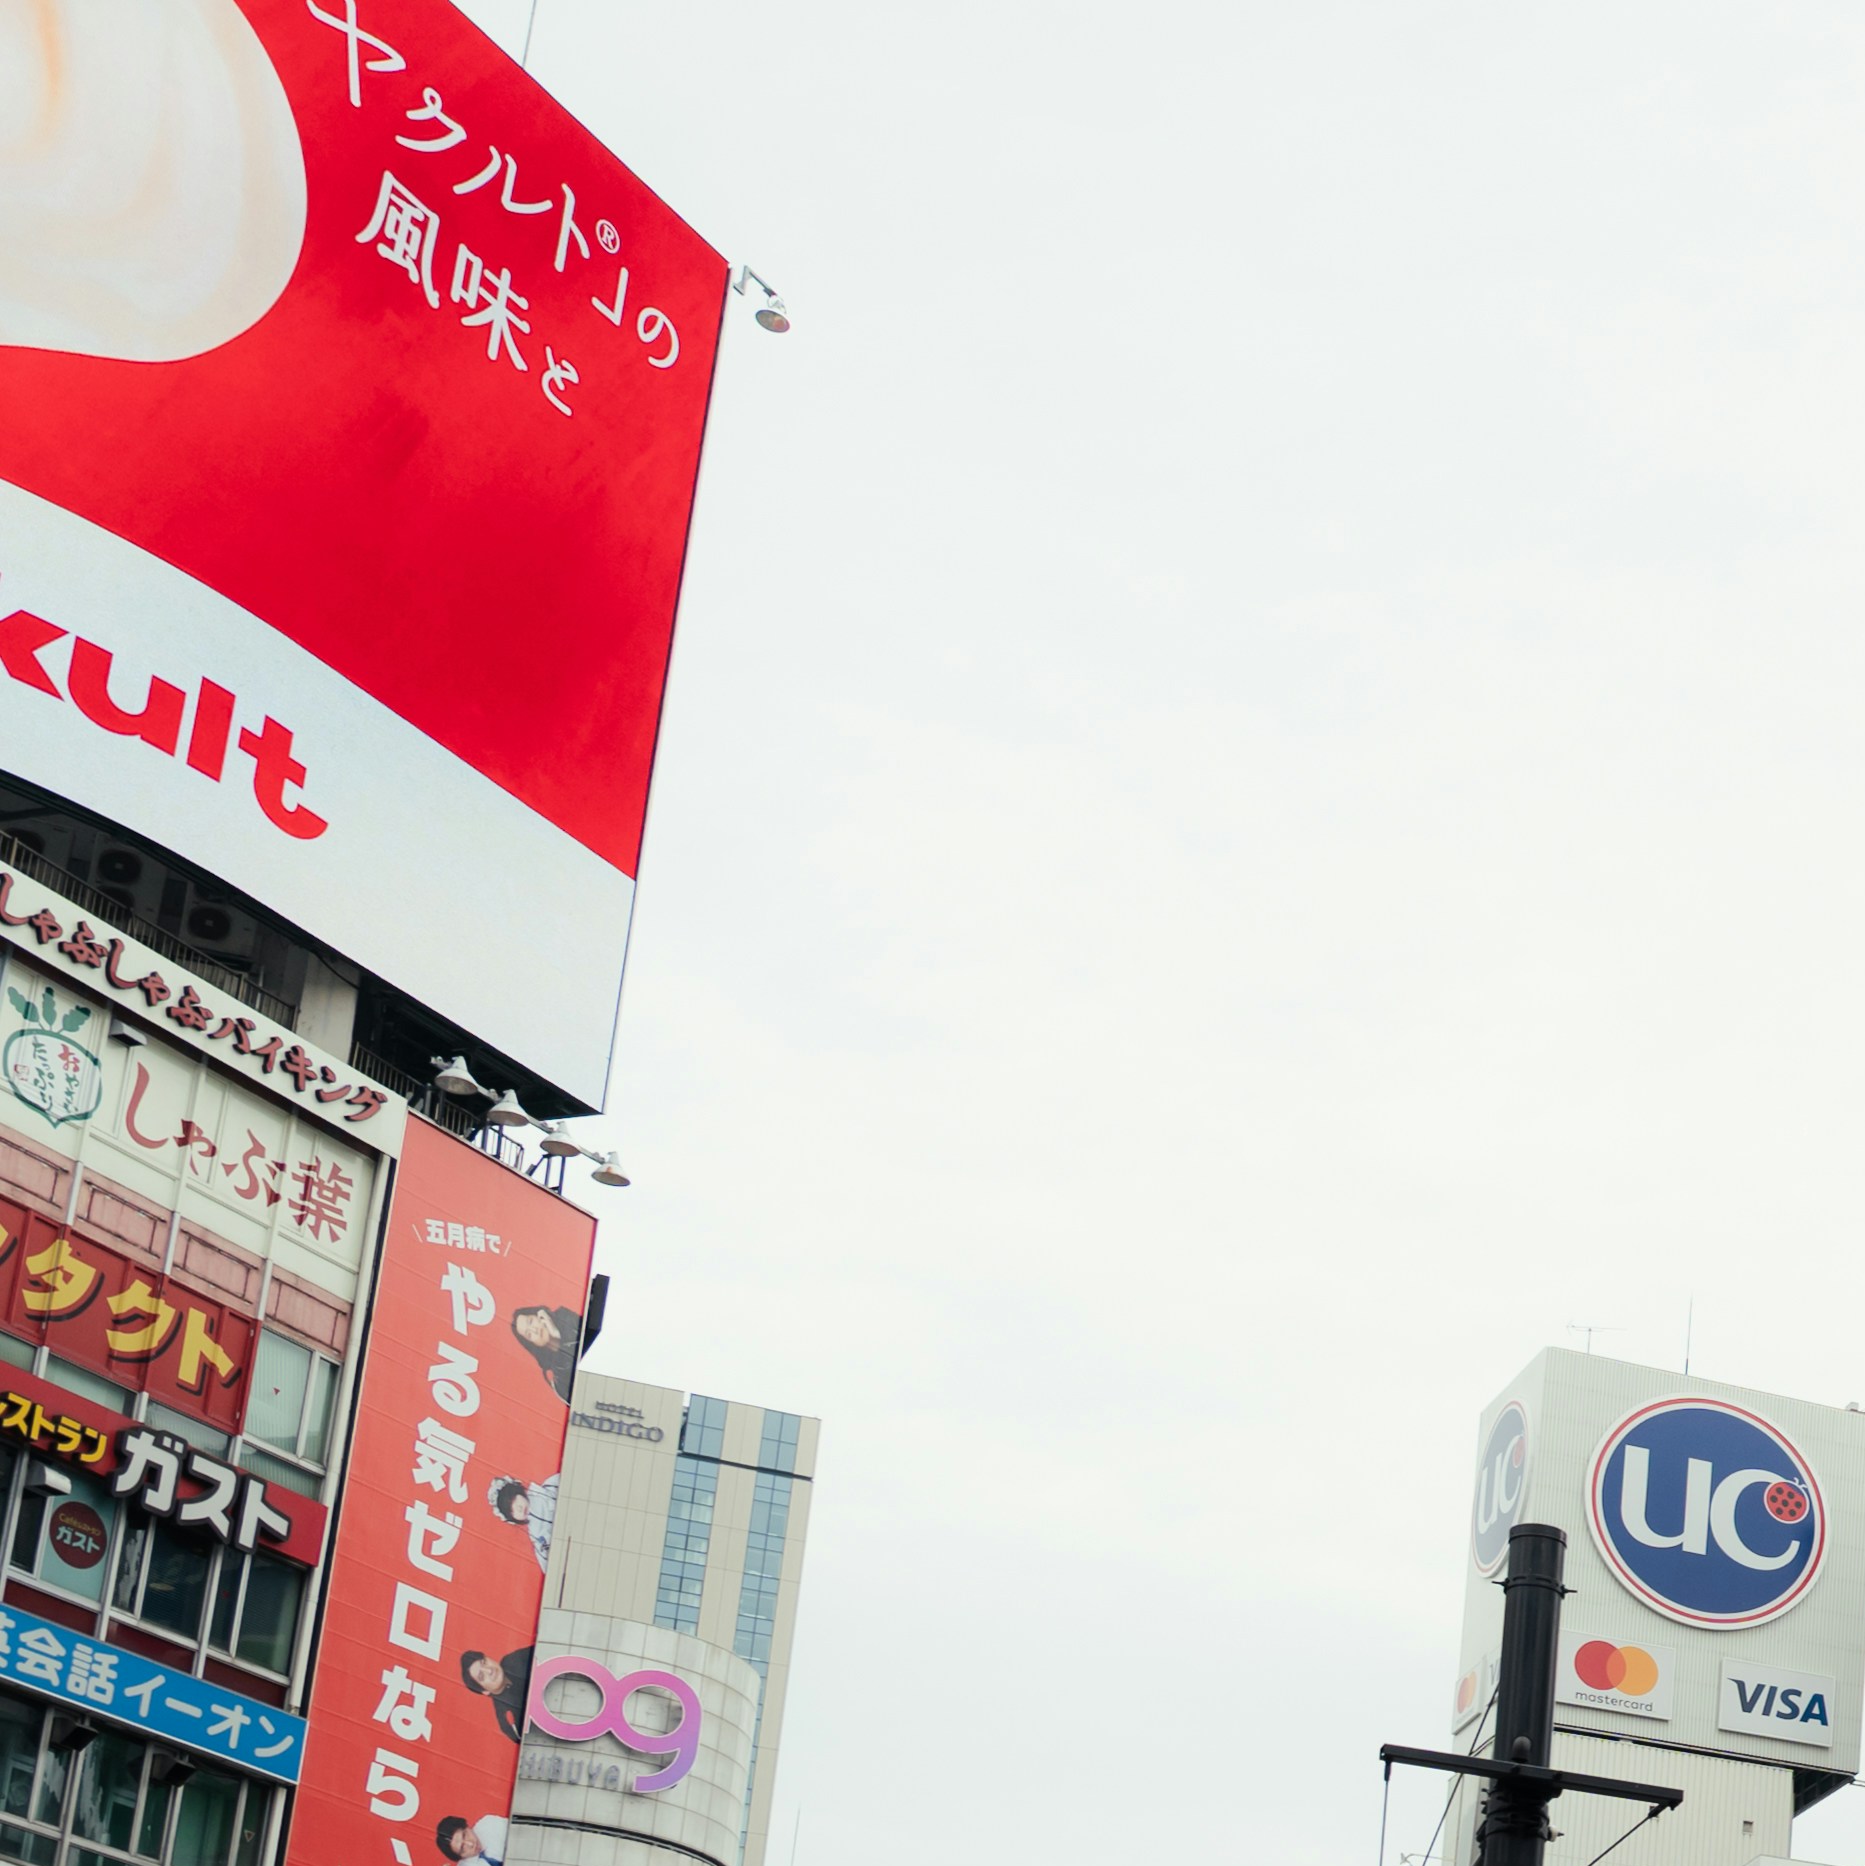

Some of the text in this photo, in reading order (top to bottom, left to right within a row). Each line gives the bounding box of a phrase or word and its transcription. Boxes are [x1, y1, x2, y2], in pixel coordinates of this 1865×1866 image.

[355, 171, 580, 417] 風味を
[126, 1061, 353, 1243] しゃぶ葉
[423, 1217, 503, 1257] 五月病で
[0, 1222, 235, 1388] タクト
[570, 1411, 665, 1444] INDIGO
[111, 1430, 291, 1550] ガスト
[56, 1525, 101, 1554] ガスト
[1575, 1689, 1653, 1713] mastercard
[1726, 1676, 1830, 1727] VISA
